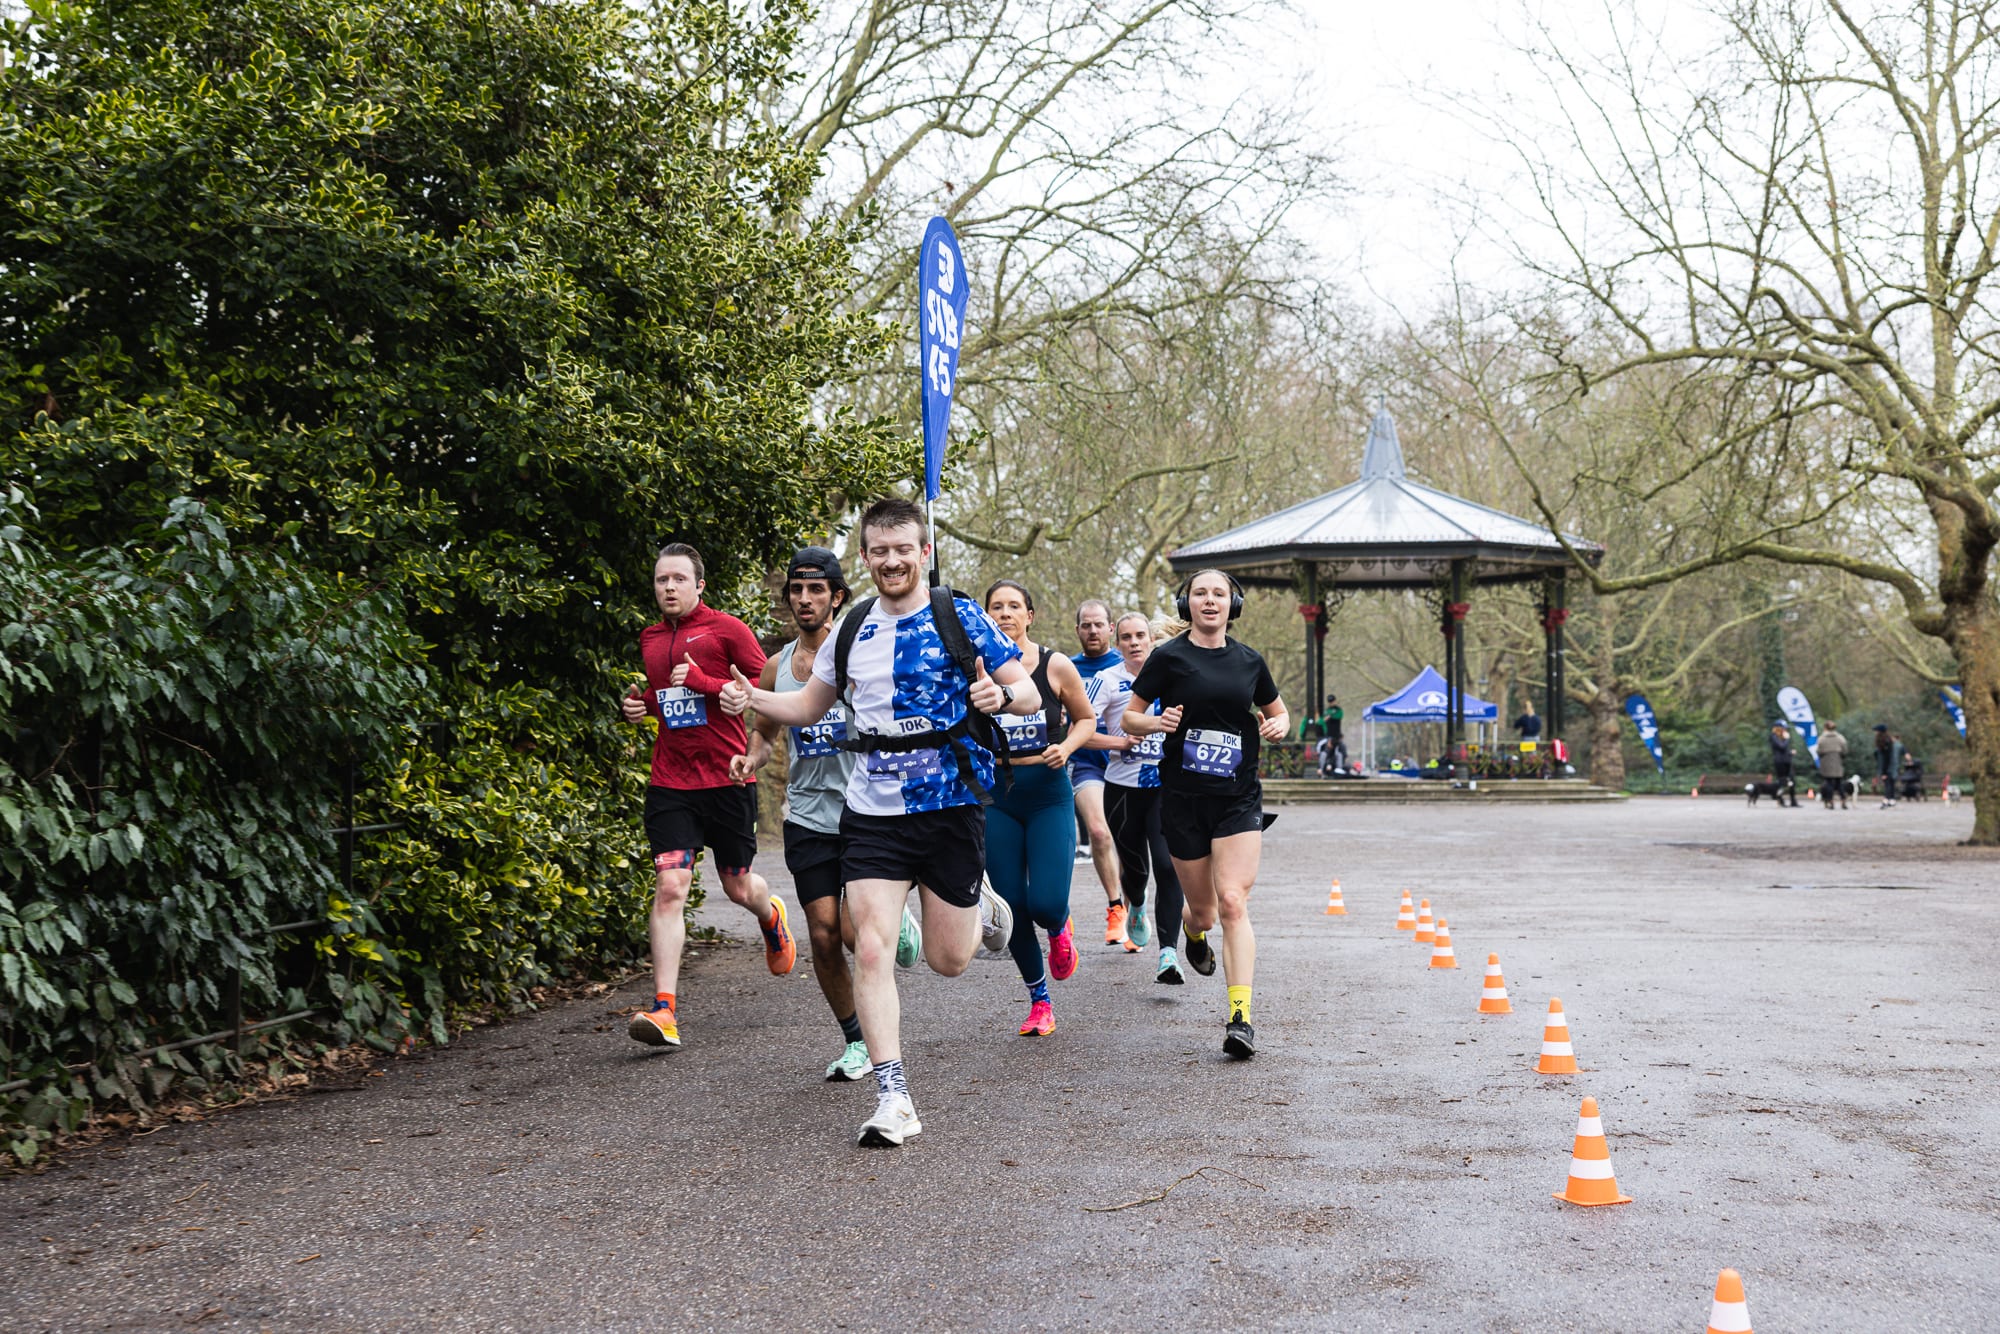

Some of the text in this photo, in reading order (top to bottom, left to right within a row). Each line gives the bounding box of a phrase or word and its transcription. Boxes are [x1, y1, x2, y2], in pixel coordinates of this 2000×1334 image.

[663, 699, 697, 718] 604
[899, 718, 925, 733] 10K
[1222, 734, 1238, 747] 10K
[1197, 743, 1233, 765] 672
